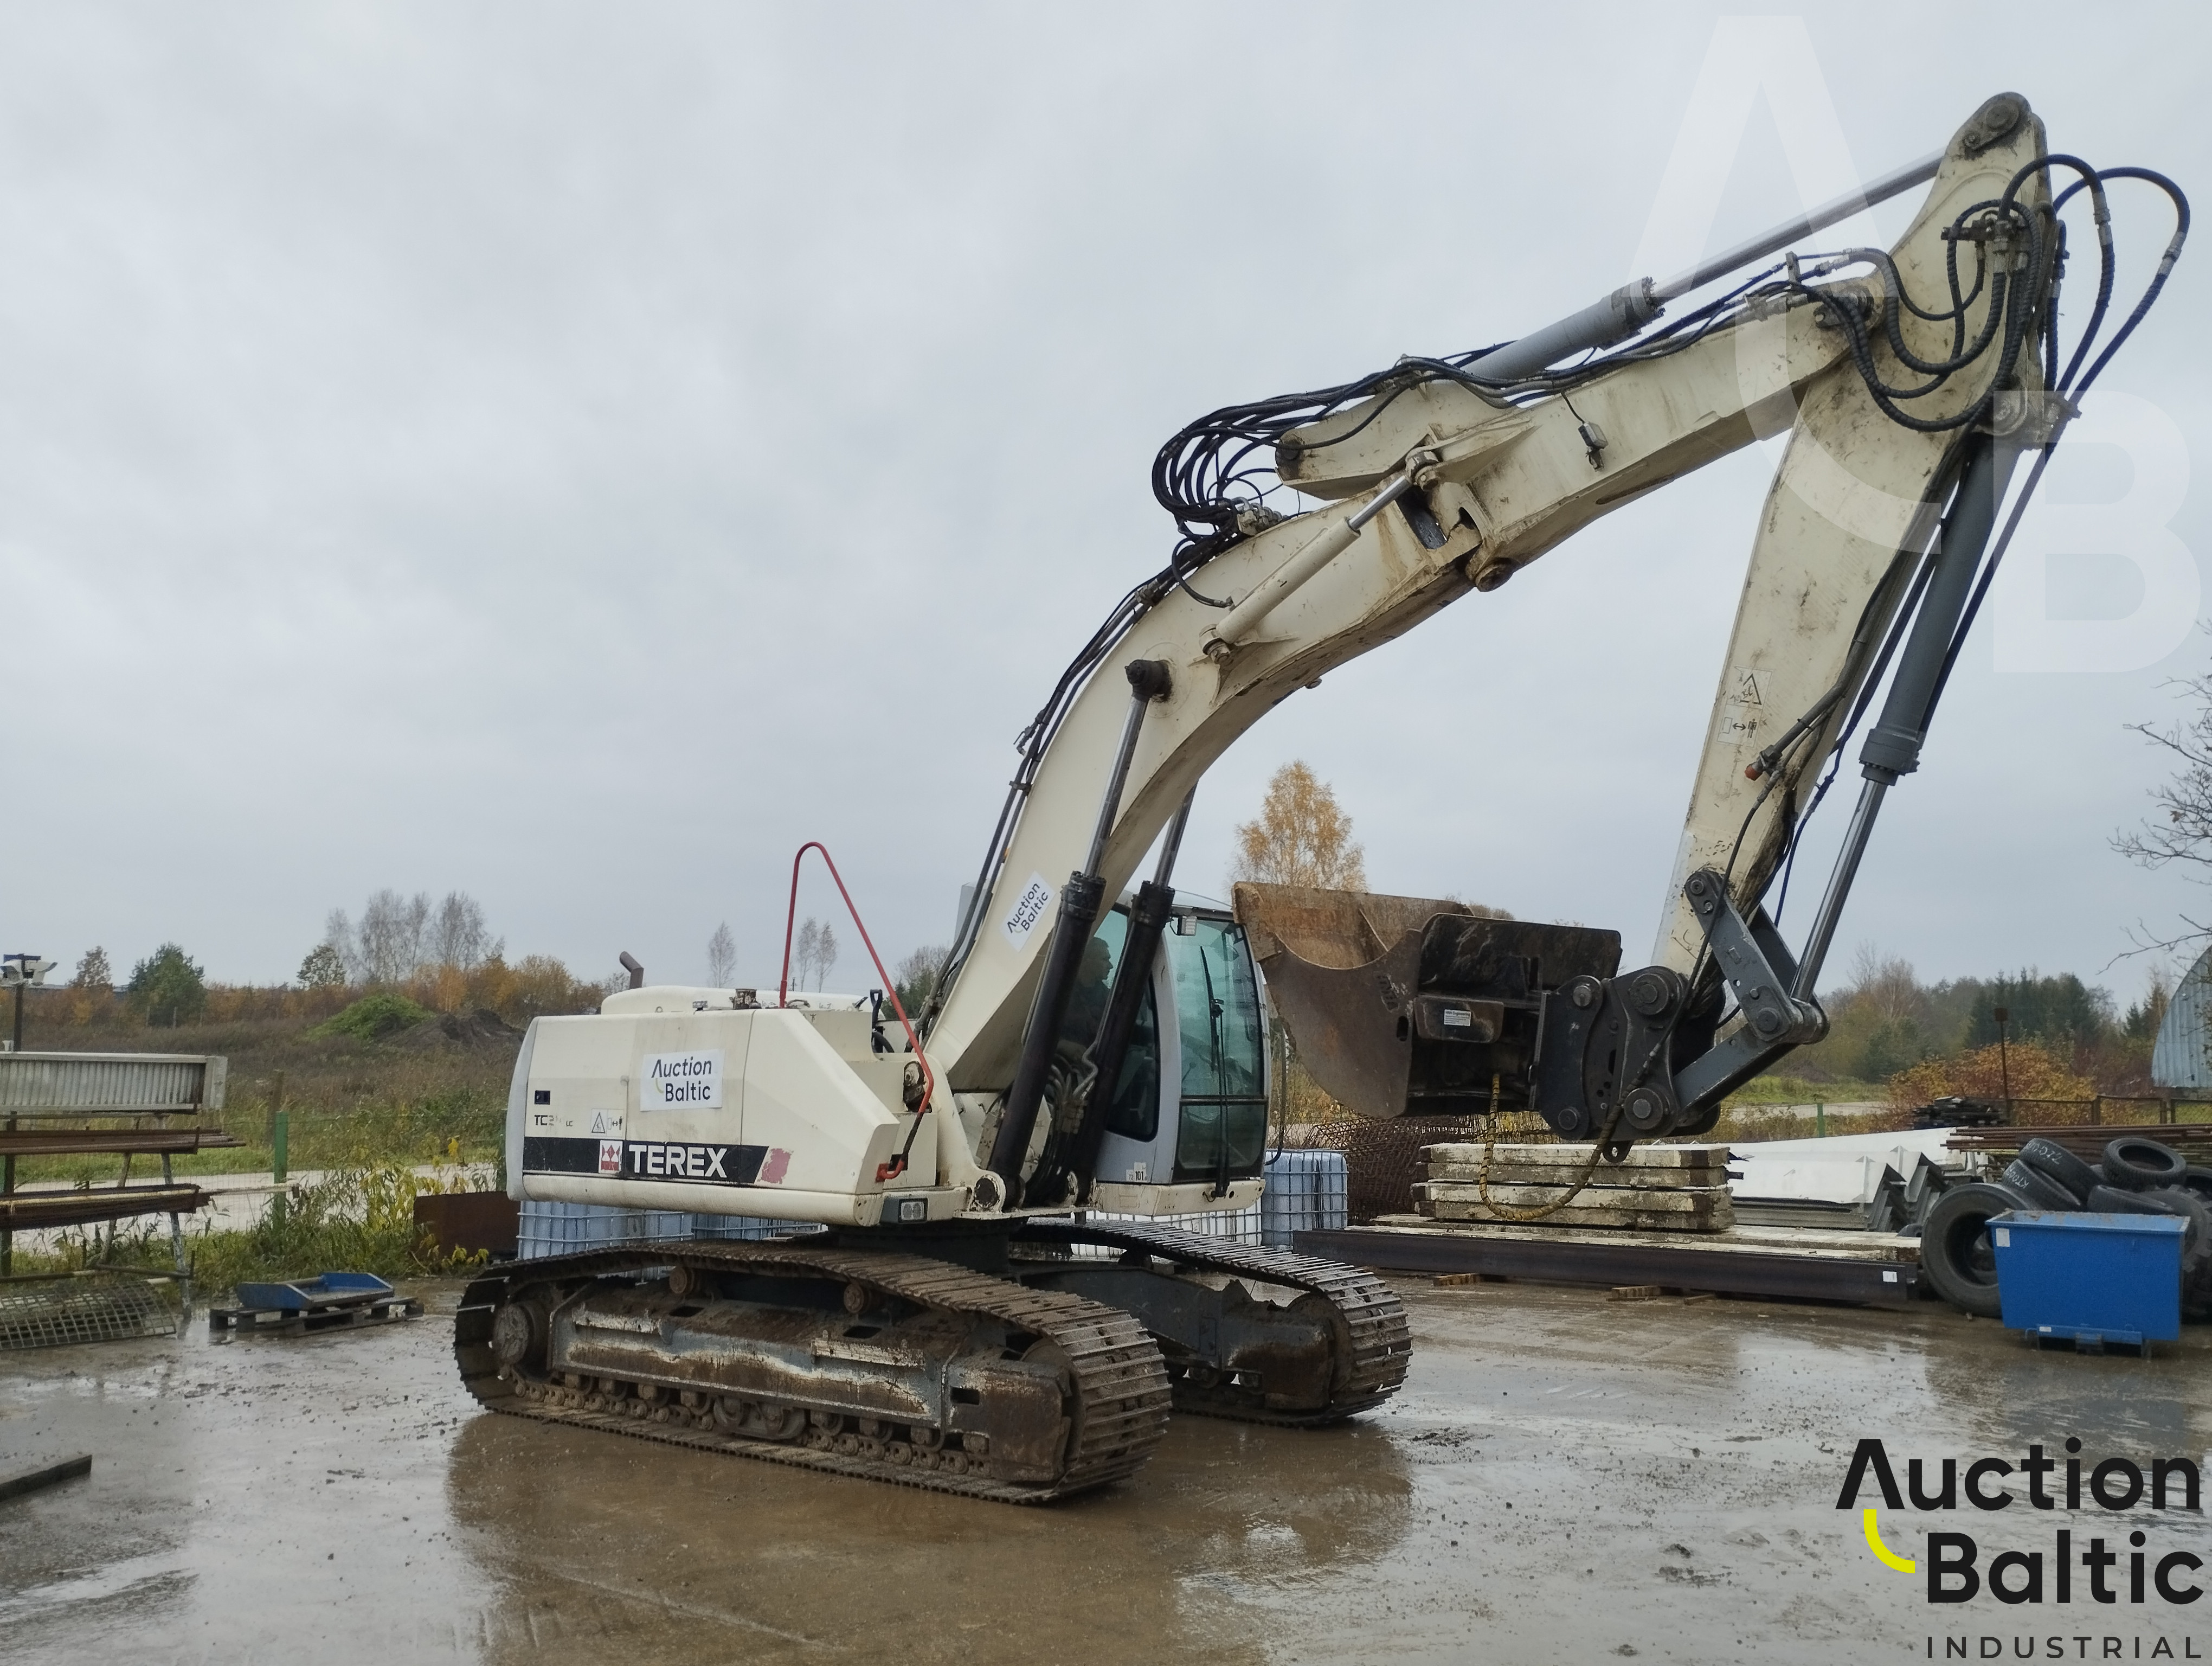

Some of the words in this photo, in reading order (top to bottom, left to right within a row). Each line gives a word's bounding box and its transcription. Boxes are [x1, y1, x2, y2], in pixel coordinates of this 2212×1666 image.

[1007, 883, 1040, 933] Auction
[1021, 892, 1048, 931] Baltic
[651, 1056, 712, 1078] Auction
[665, 1080, 711, 1102] Baltic
[629, 1144, 728, 1178] TEREX
[1135, 1171, 1143, 1181] 101
